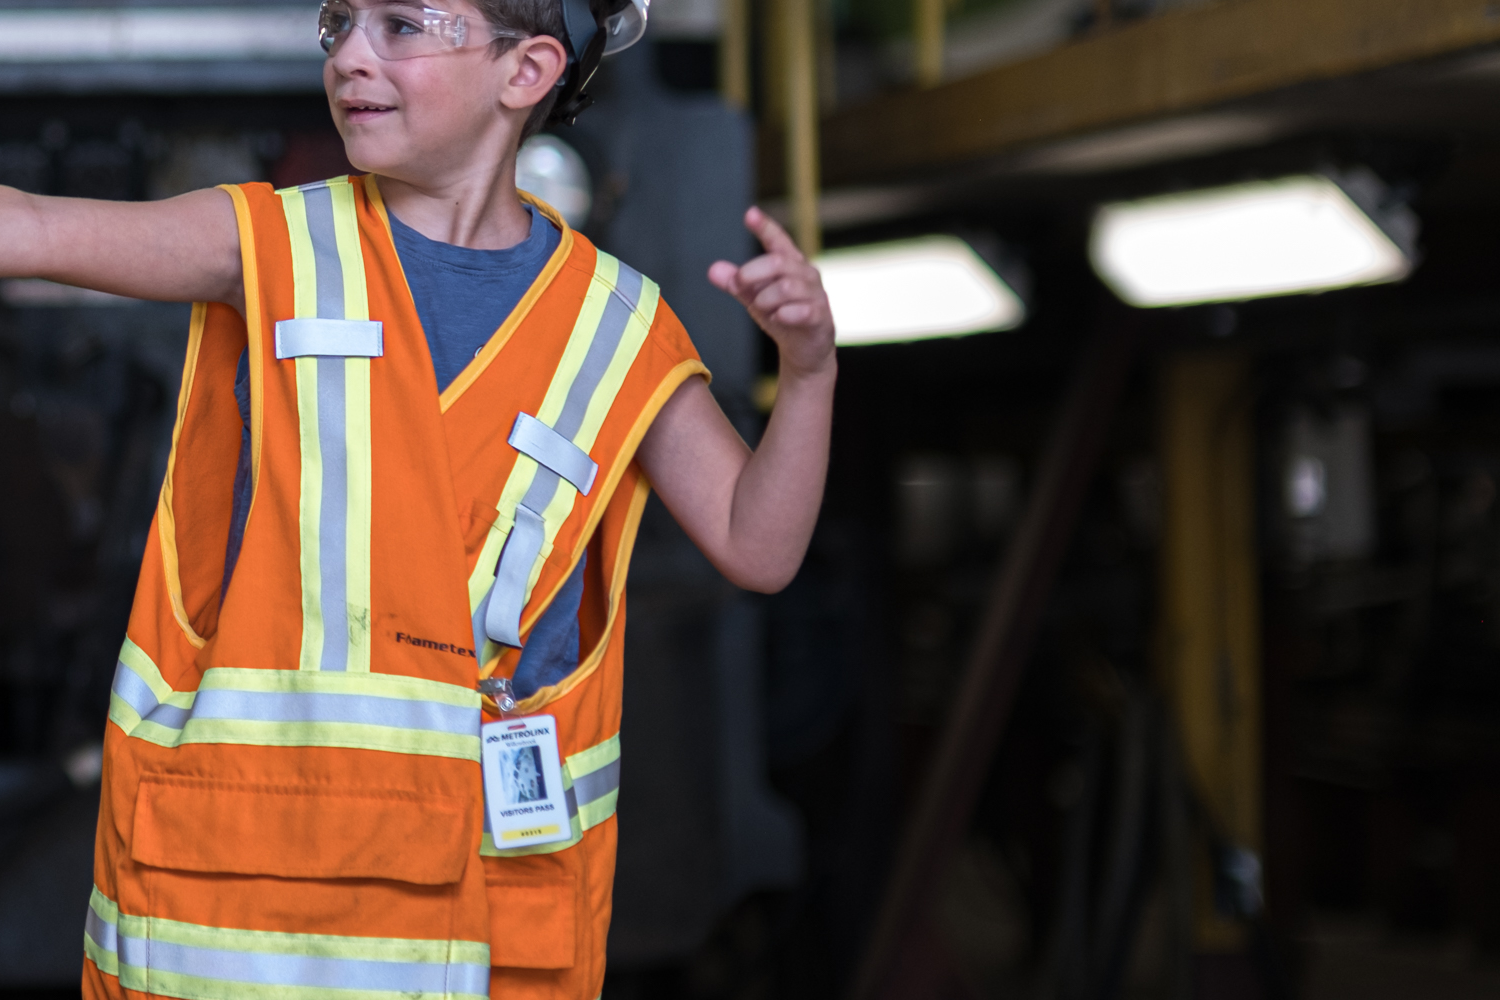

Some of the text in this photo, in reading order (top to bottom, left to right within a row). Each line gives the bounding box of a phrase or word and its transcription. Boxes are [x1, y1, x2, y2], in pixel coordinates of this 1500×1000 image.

[501, 727, 550, 741] METROLINX
[500, 803, 555, 818] VISITORS PASS
